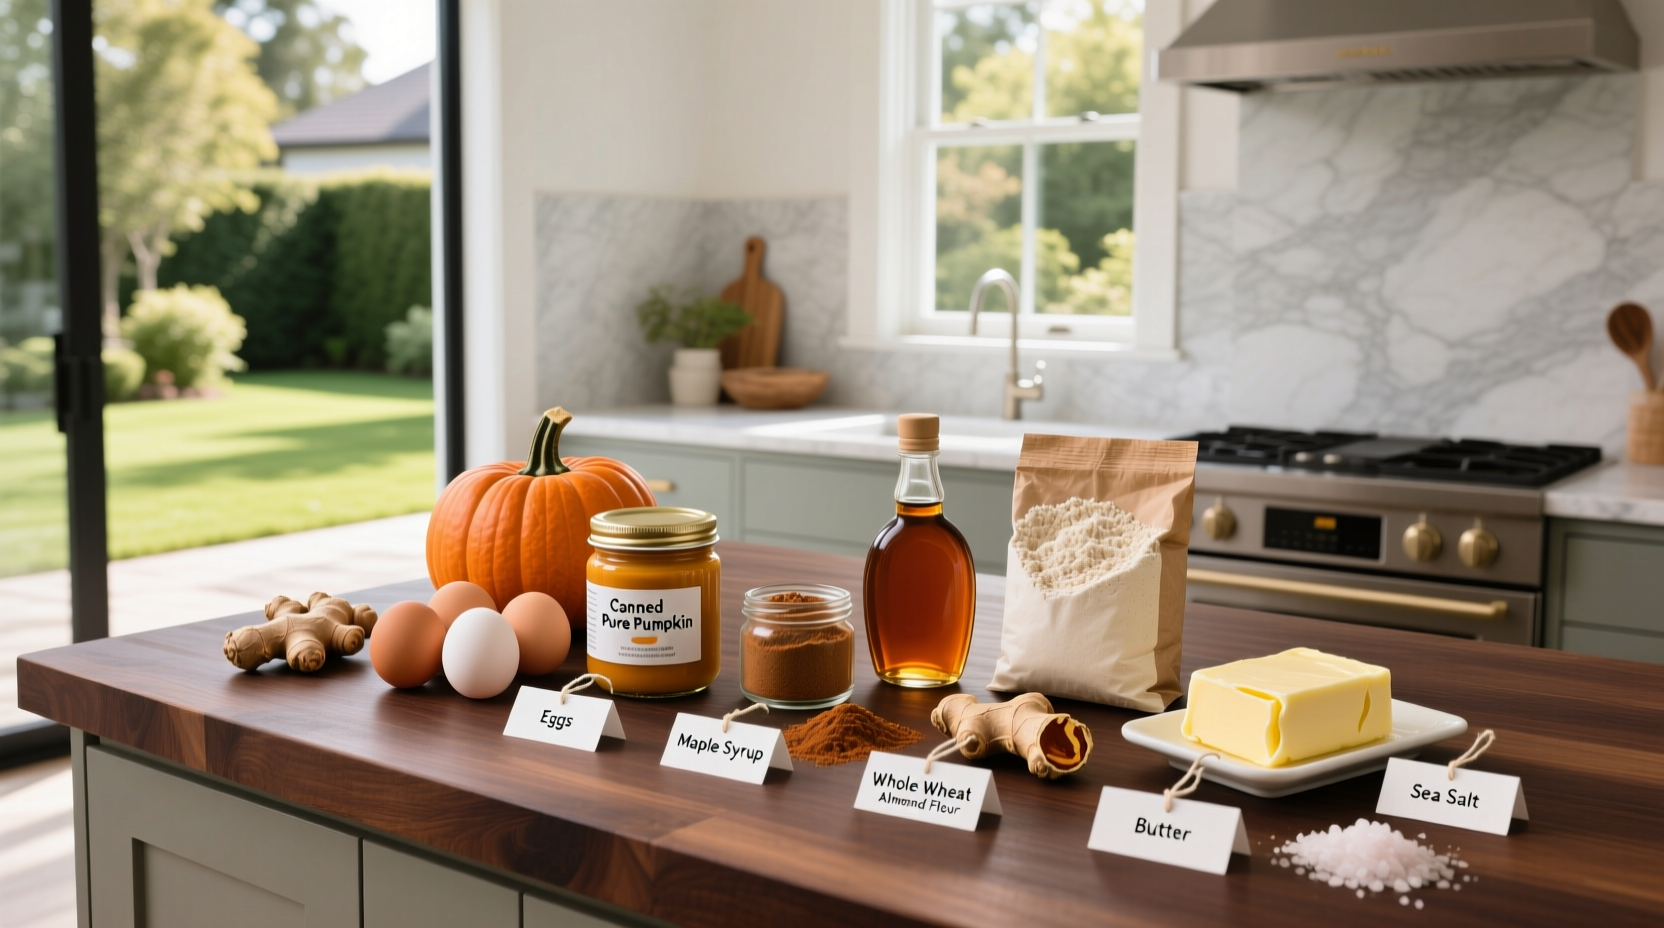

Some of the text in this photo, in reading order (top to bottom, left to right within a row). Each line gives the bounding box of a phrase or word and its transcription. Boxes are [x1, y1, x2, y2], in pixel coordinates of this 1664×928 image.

[610, 598, 663, 613] Canned
[602, 613, 693, 633] Pure Pumpkin
[540, 709, 574, 730] Eggs
[677, 733, 764, 764] Maple Syrup
[873, 771, 972, 801] Whole Wheat
[1410, 783, 1480, 809] Sea Salt
[1135, 817, 1192, 841] Butter
